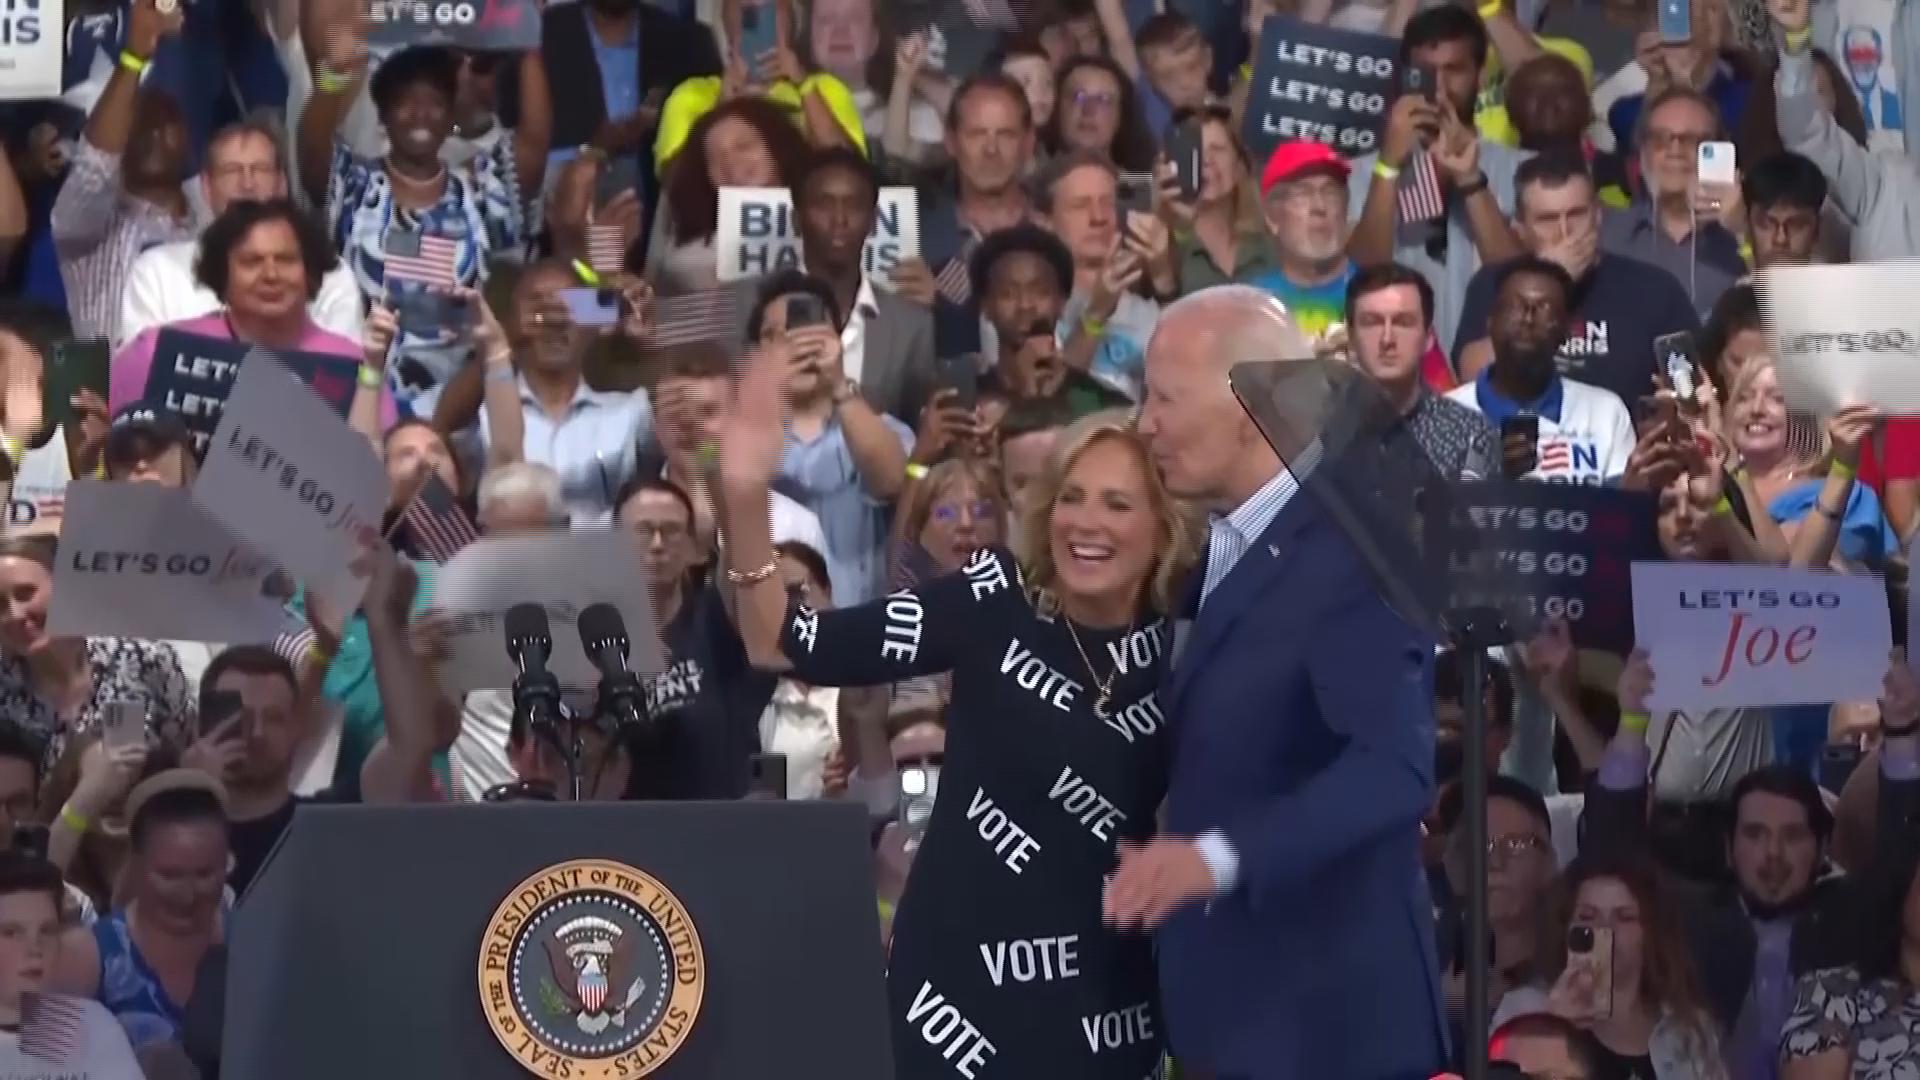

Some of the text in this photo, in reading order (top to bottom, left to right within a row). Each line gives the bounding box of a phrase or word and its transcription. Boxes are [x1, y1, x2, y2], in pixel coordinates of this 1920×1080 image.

[435, 2, 476, 25] GO
[1278, 40, 1394, 78] LET'S GO
[1270, 76, 1385, 114] LET'S GO
[1262, 112, 1376, 149] LET'S GO
[174, 353, 240, 382] LET'
[228, 425, 300, 490] LET'S
[298, 477, 335, 516] GO
[1452, 506, 1538, 531] ET'S
[1543, 508, 1588, 533] GO
[72, 550, 159, 576] LET'S
[165, 553, 212, 576] GO
[1543, 551, 1588, 577] GO
[1543, 595, 1585, 622] GO
[1679, 588, 1842, 610] LET'S GO
[1701, 611, 1817, 687] Joe
[1000, 635, 1085, 713] VOTE
[1104, 690, 1166, 744] VOT
[1048, 764, 1128, 843] VOTE
[966, 785, 1042, 875] VOTE
[486, 867, 697, 1078] SEAL OF THE PRESIDENT OF THE UNITED STATES
[979, 934, 1080, 987] VOTE
[905, 979, 998, 1080] VOTE
[1081, 1001, 1154, 1053] VOTE
